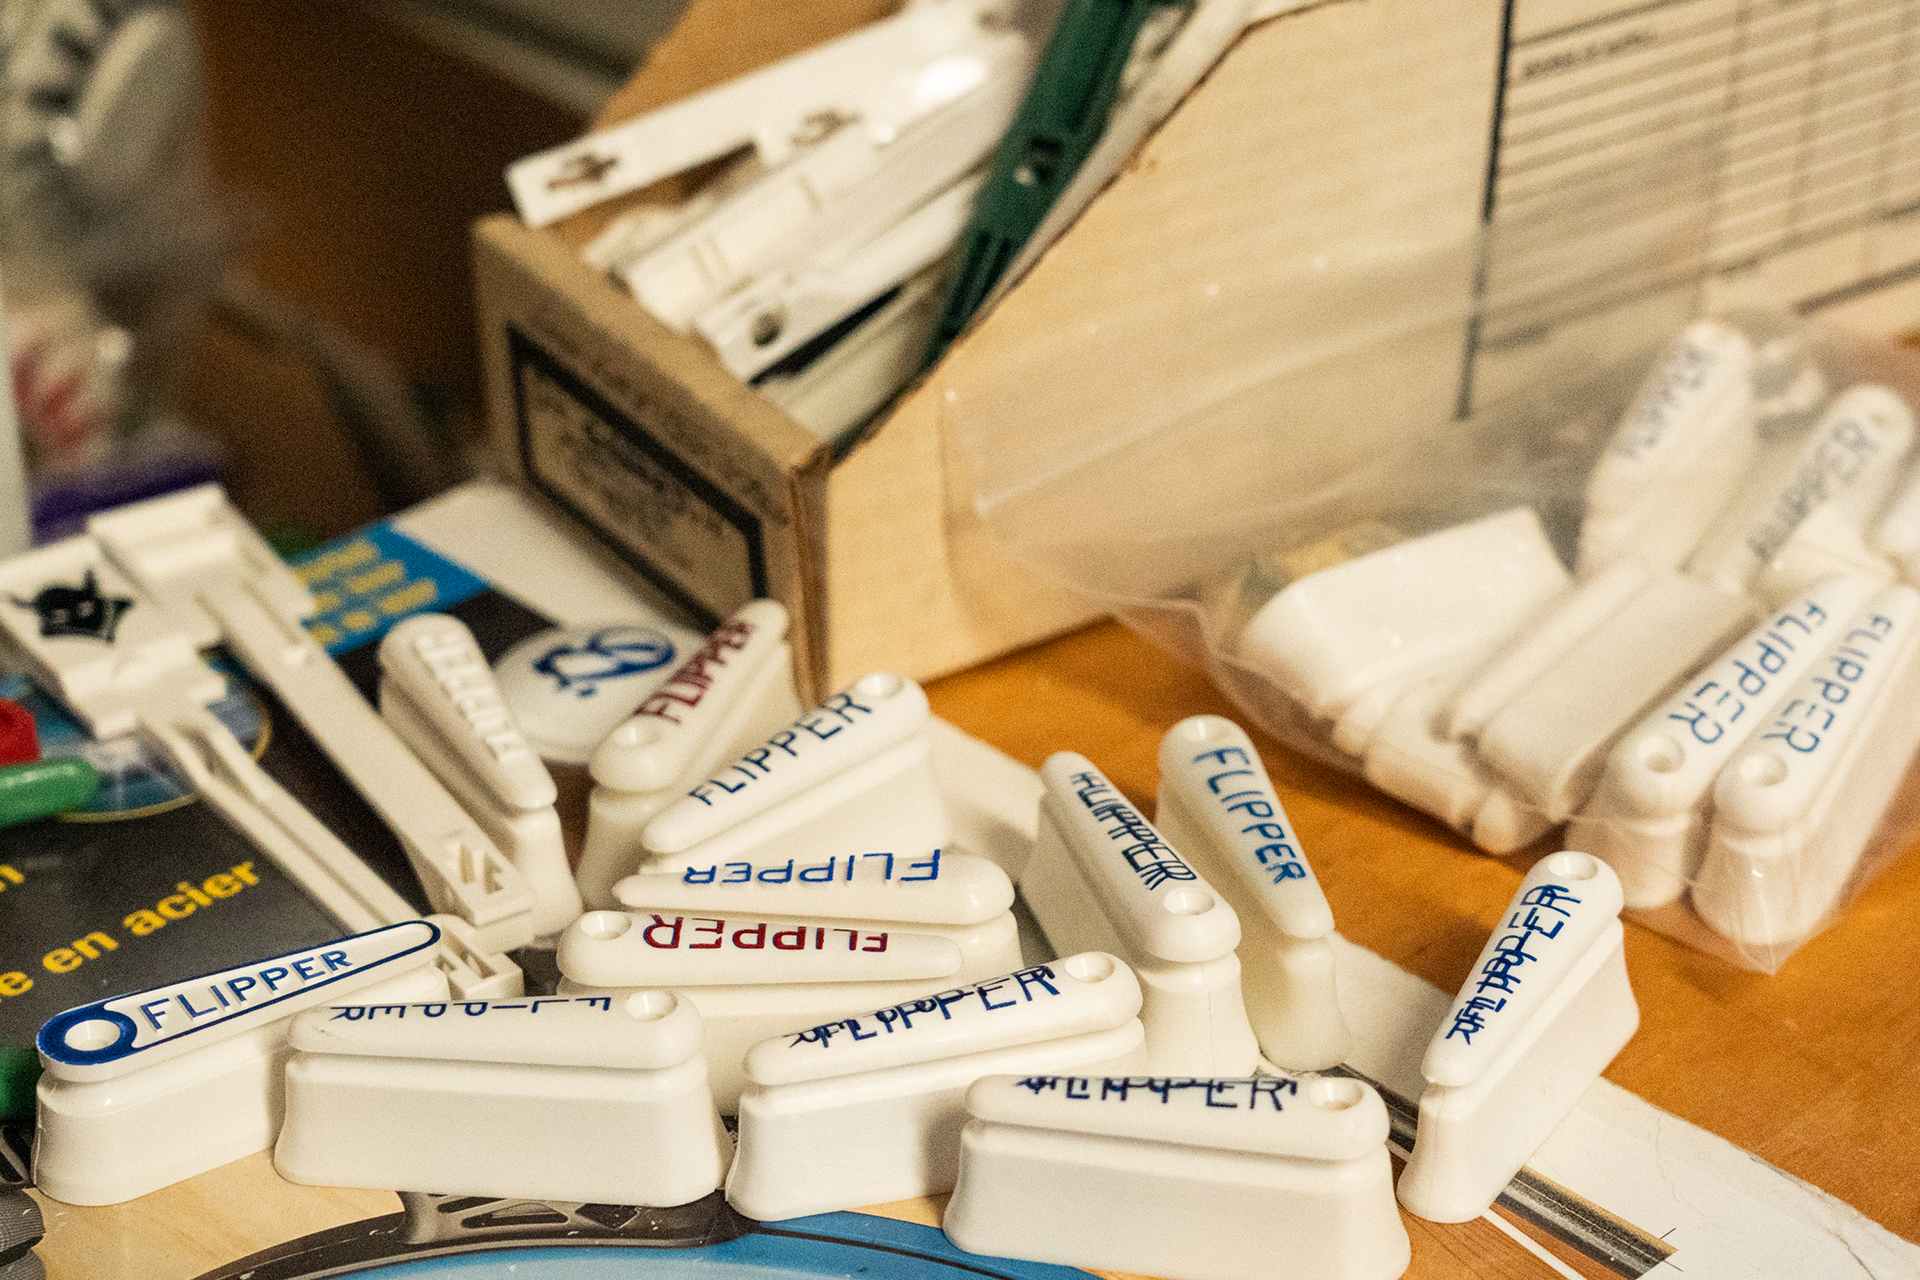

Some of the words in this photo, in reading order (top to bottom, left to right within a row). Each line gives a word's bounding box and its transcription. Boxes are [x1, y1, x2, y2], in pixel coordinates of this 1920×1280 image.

[633, 619, 756, 726] FLIPPER
[1668, 600, 1828, 745] FLIPPER
[1761, 613, 1894, 754] FLIPPER
[687, 690, 875, 807] FLIPPER
[683, 848, 942, 885] FLIPPER
[1192, 746, 1307, 885] FLIPPER
[42, 931, 119, 974] en
[123, 861, 260, 937] acier
[642, 913, 889, 953] FLIPPER
[138, 948, 355, 1034] FLIPPER
[328, 996, 612, 1021] FLIPPER
